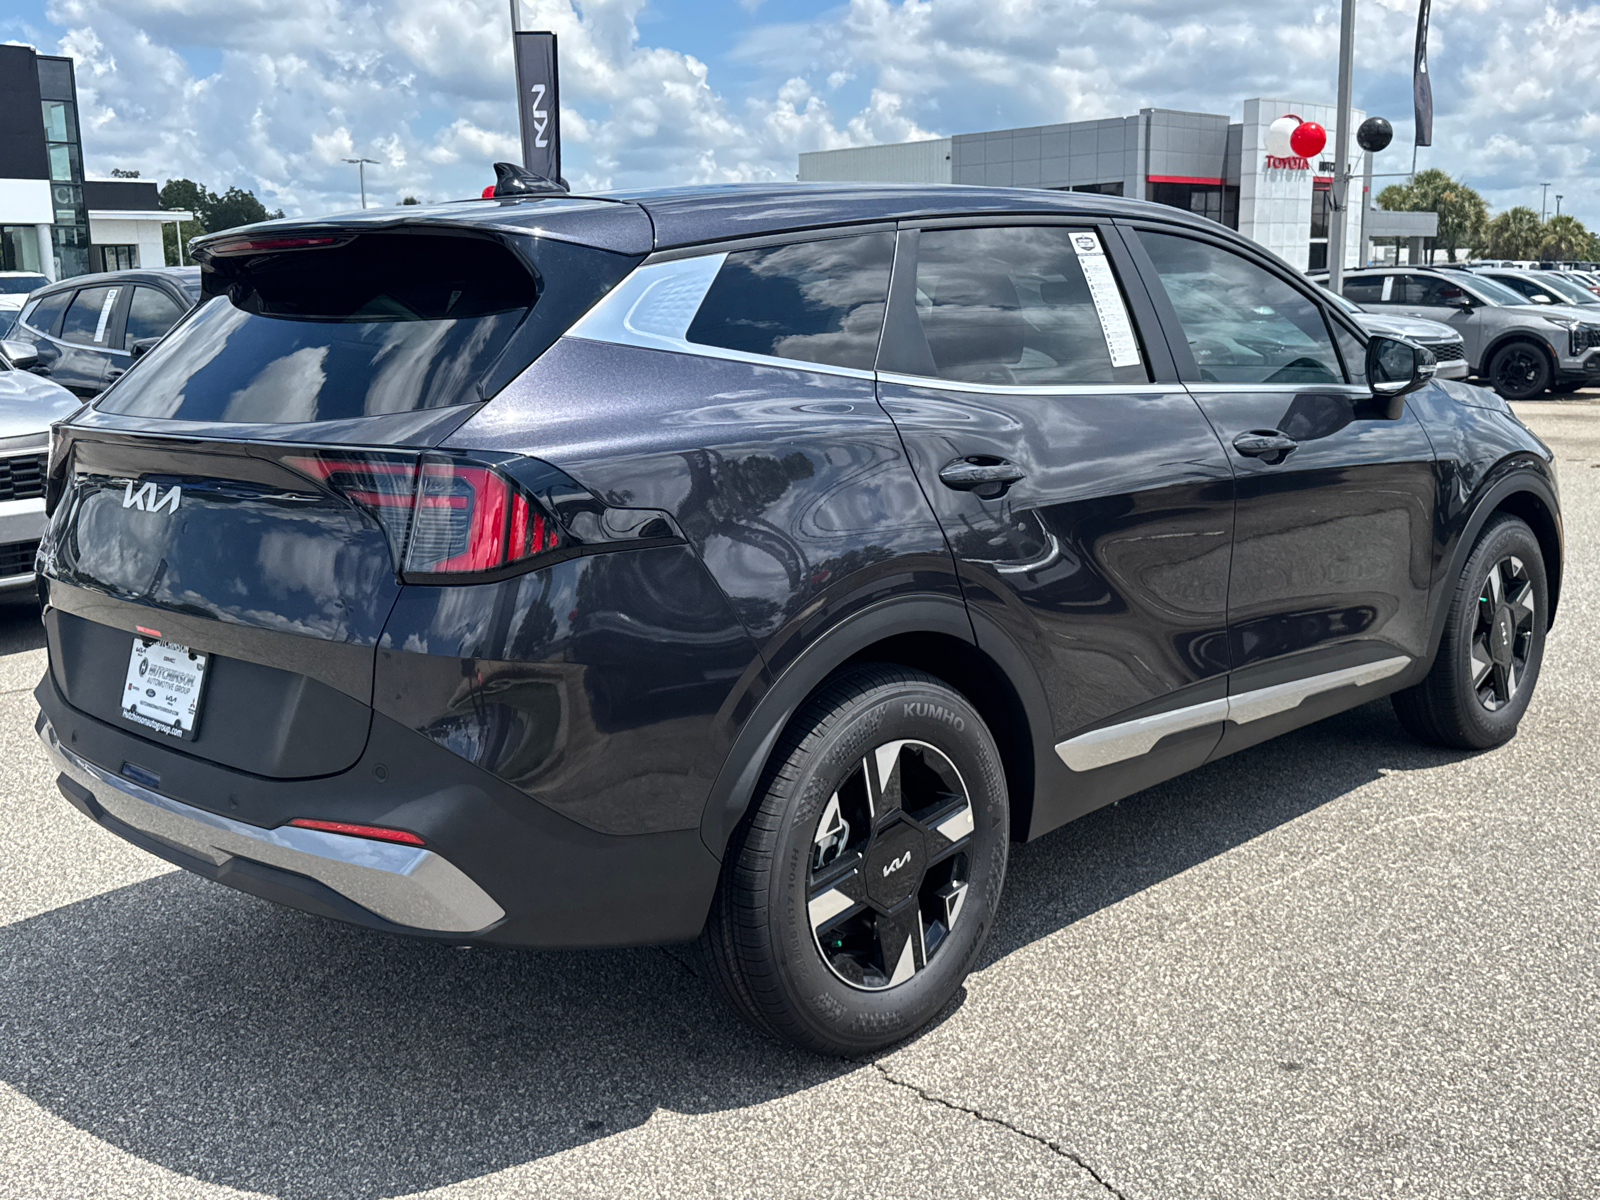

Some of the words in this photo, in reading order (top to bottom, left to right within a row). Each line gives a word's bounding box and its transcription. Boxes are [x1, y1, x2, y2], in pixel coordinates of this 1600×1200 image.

[1265, 155, 1309, 170] TOYOTA
[122, 479, 181, 515] KIA
[174, 684, 191, 694] GROUP
[903, 702, 965, 731] KUMHO
[882, 850, 912, 877] KIA
